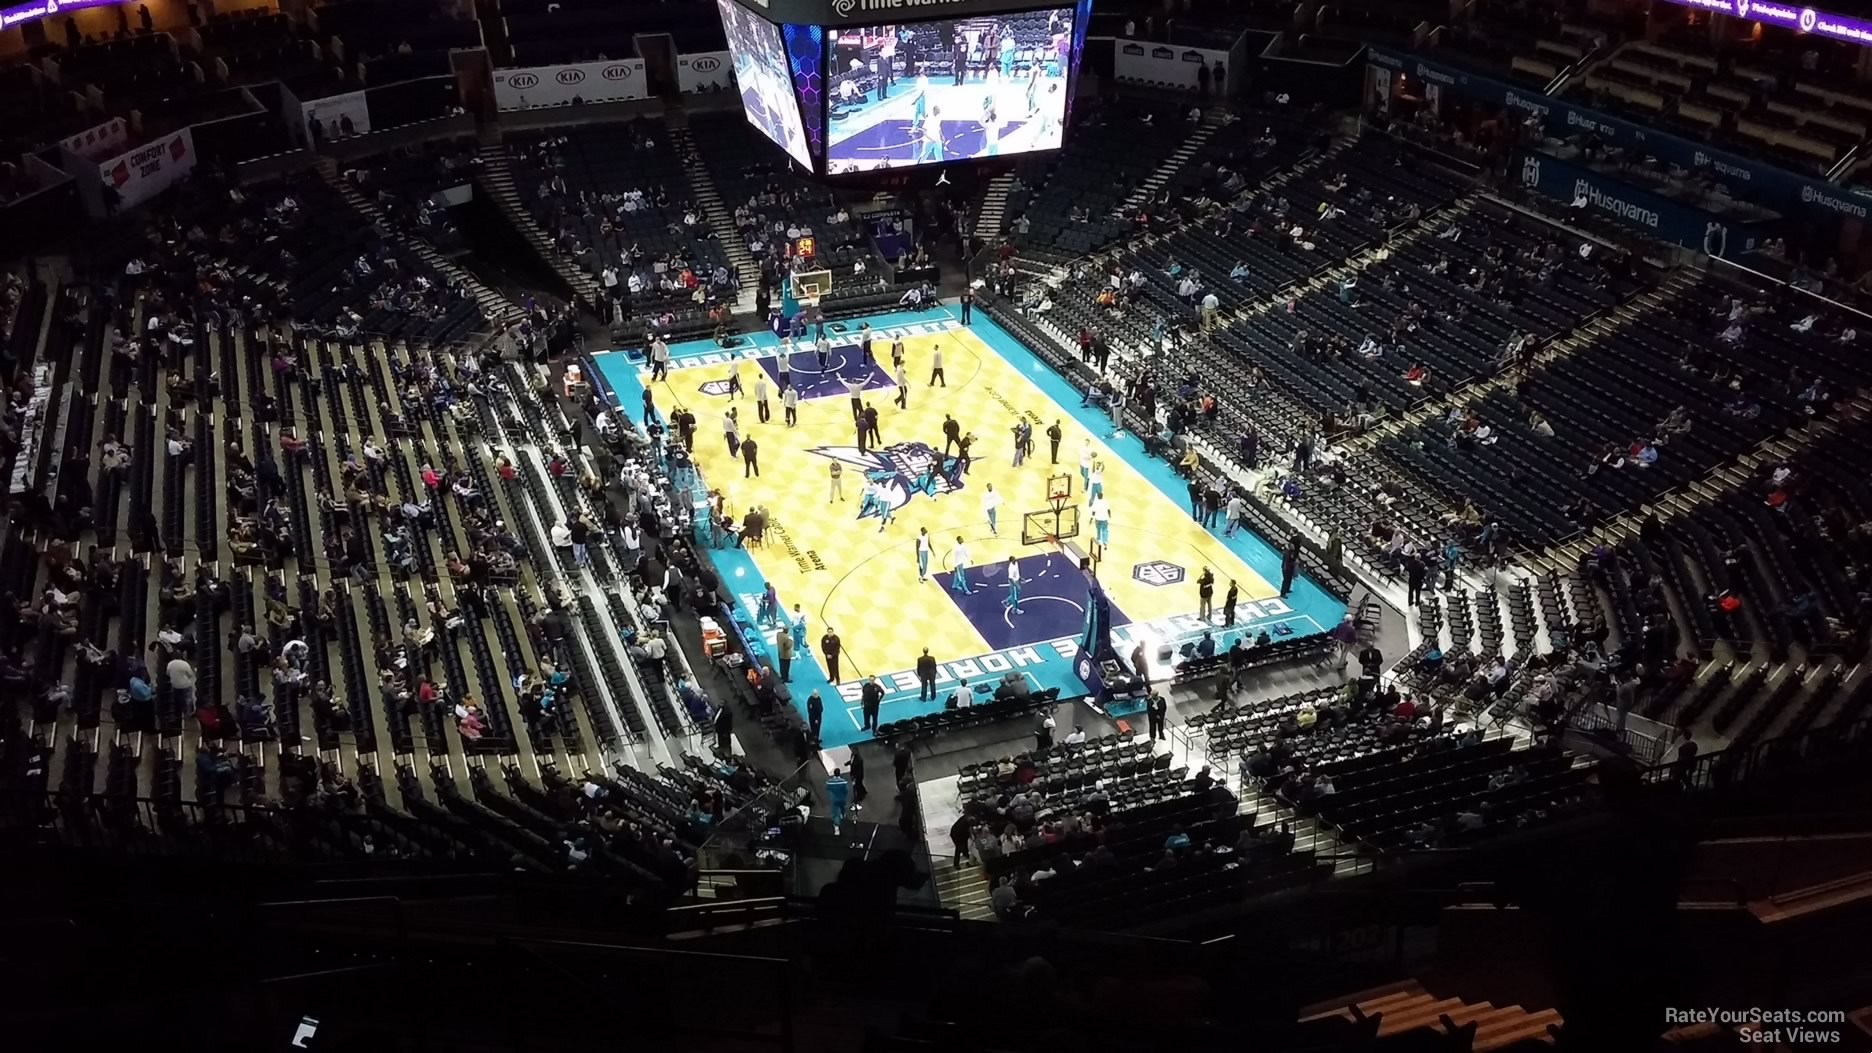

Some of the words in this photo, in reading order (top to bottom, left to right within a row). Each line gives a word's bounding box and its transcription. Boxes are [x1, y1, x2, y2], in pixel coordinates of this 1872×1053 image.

[606, 67, 626, 78] KIA
[696, 59, 716, 70] KIA
[513, 75, 533, 87] KIA
[560, 71, 580, 82] KIA
[130, 143, 167, 168] COMFORT
[140, 160, 161, 178] ZONE
[1704, 156, 1751, 181] Hsqvarna
[1589, 185, 1659, 228] Husqvarna
[1812, 191, 1867, 218] Husqvarna
[799, 246, 812, 255] 24
[780, 535, 801, 558] Warner
[795, 556, 812, 574] Time
[807, 550, 827, 570] Arena
